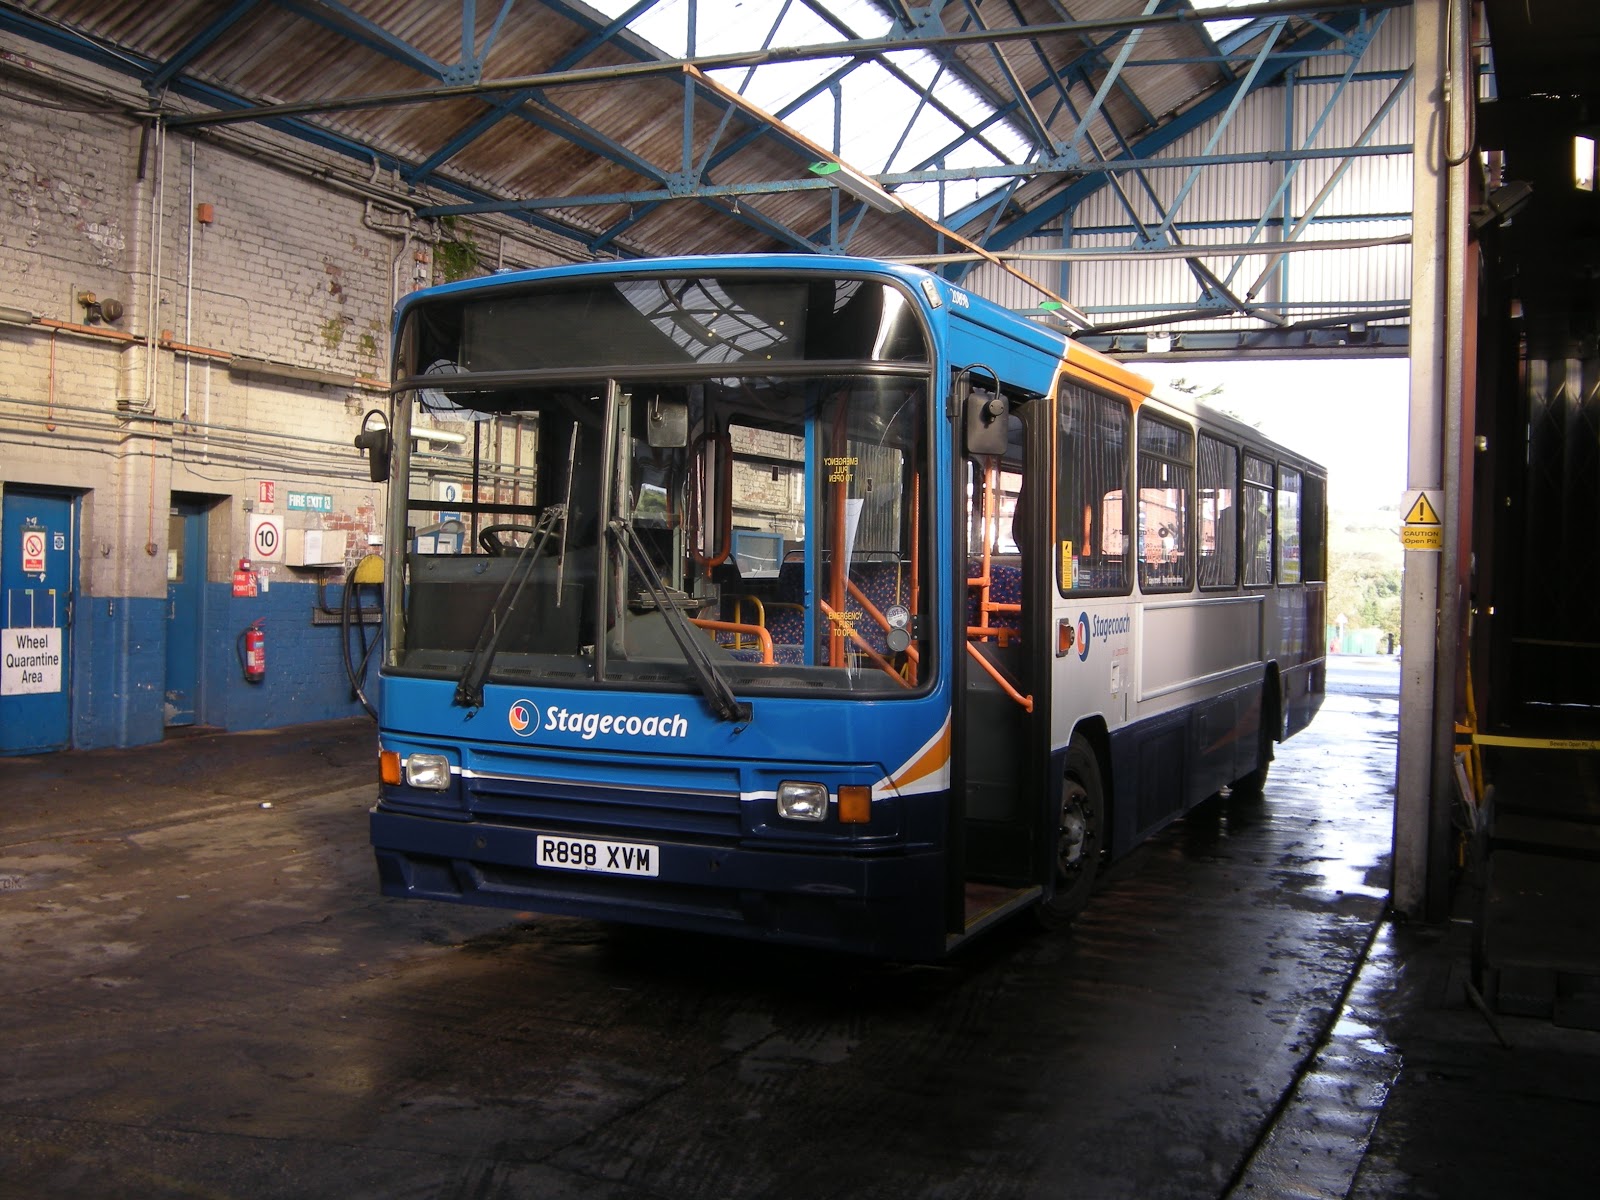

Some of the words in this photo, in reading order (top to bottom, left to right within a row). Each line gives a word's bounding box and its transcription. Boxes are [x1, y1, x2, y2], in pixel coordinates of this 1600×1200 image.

[288, 494, 306, 507] FIRE
[306, 495, 323, 509] EXIT
[258, 530, 275, 547] 10
[234, 574, 246, 582] FIRE
[233, 584, 248, 592] POINT
[828, 611, 863, 620] EMERGENCY
[838, 620, 854, 628] PUSH
[1092, 612, 1131, 643] Stagecoach
[833, 628, 842, 637] TO
[842, 628, 858, 637] OPEN
[16, 634, 48, 649] Wheel
[6, 652, 59, 668] Quarantine
[21, 669, 43, 684] Area
[544, 705, 688, 740] Stagecoach
[542, 839, 597, 866] R898
[606, 845, 650, 872] XVM
